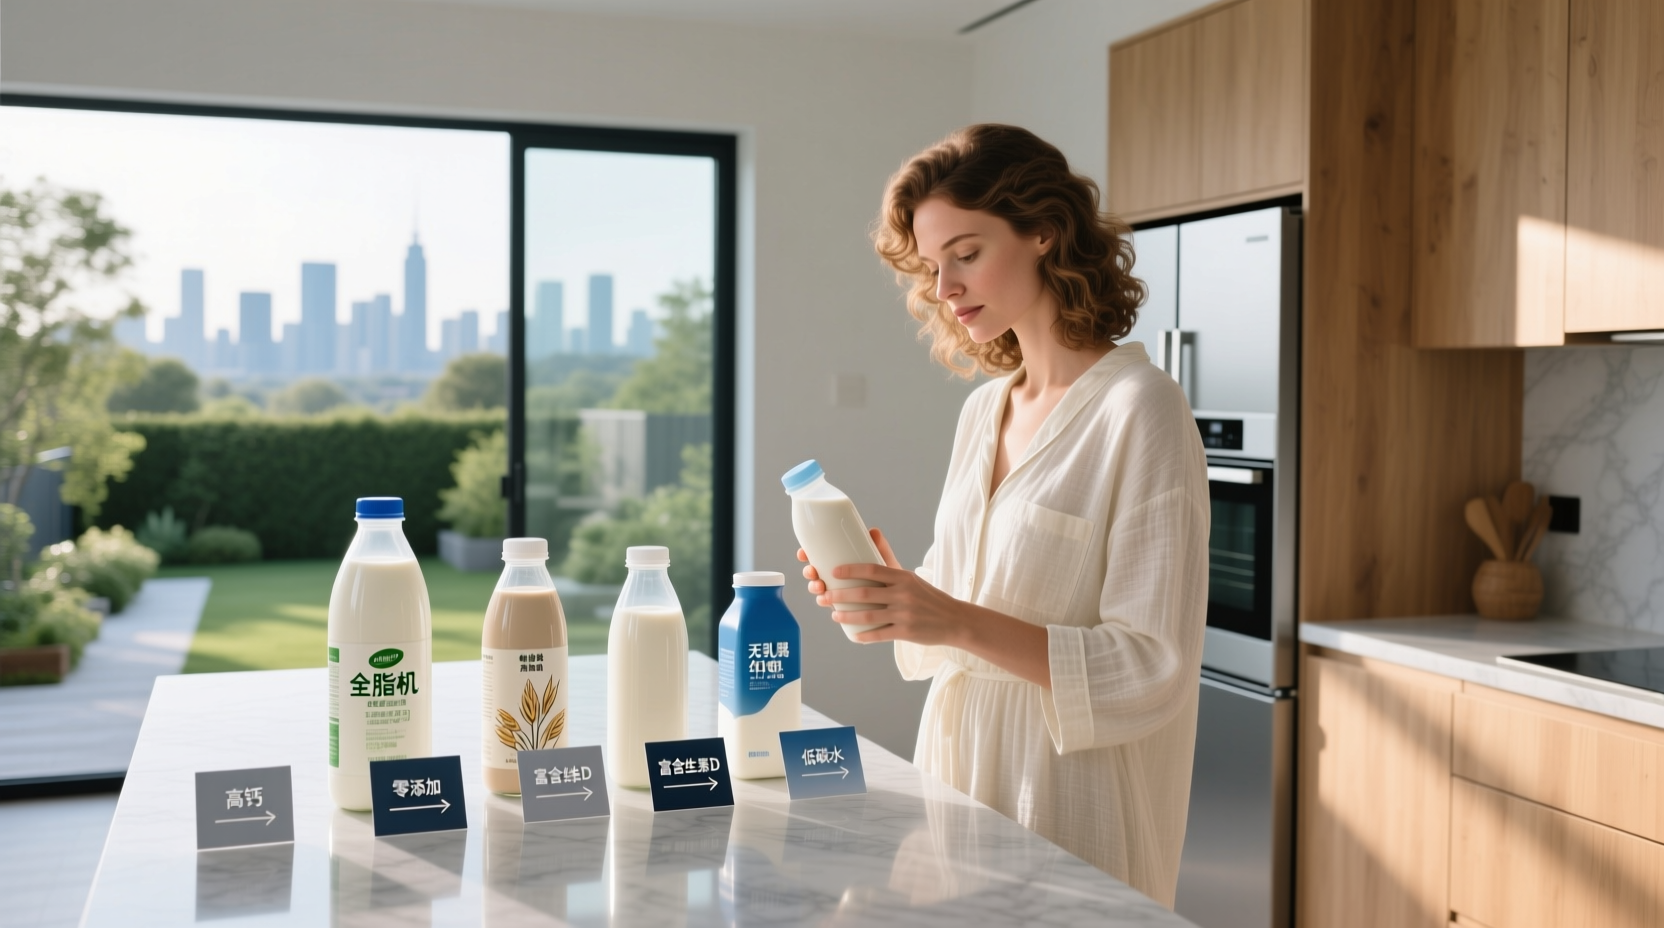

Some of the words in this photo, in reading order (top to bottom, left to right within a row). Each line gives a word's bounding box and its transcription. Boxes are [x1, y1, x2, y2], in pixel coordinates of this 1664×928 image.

[350, 671, 419, 697] 全脂机
[225, 786, 263, 810] 高钙
[392, 777, 441, 798] 零添加
